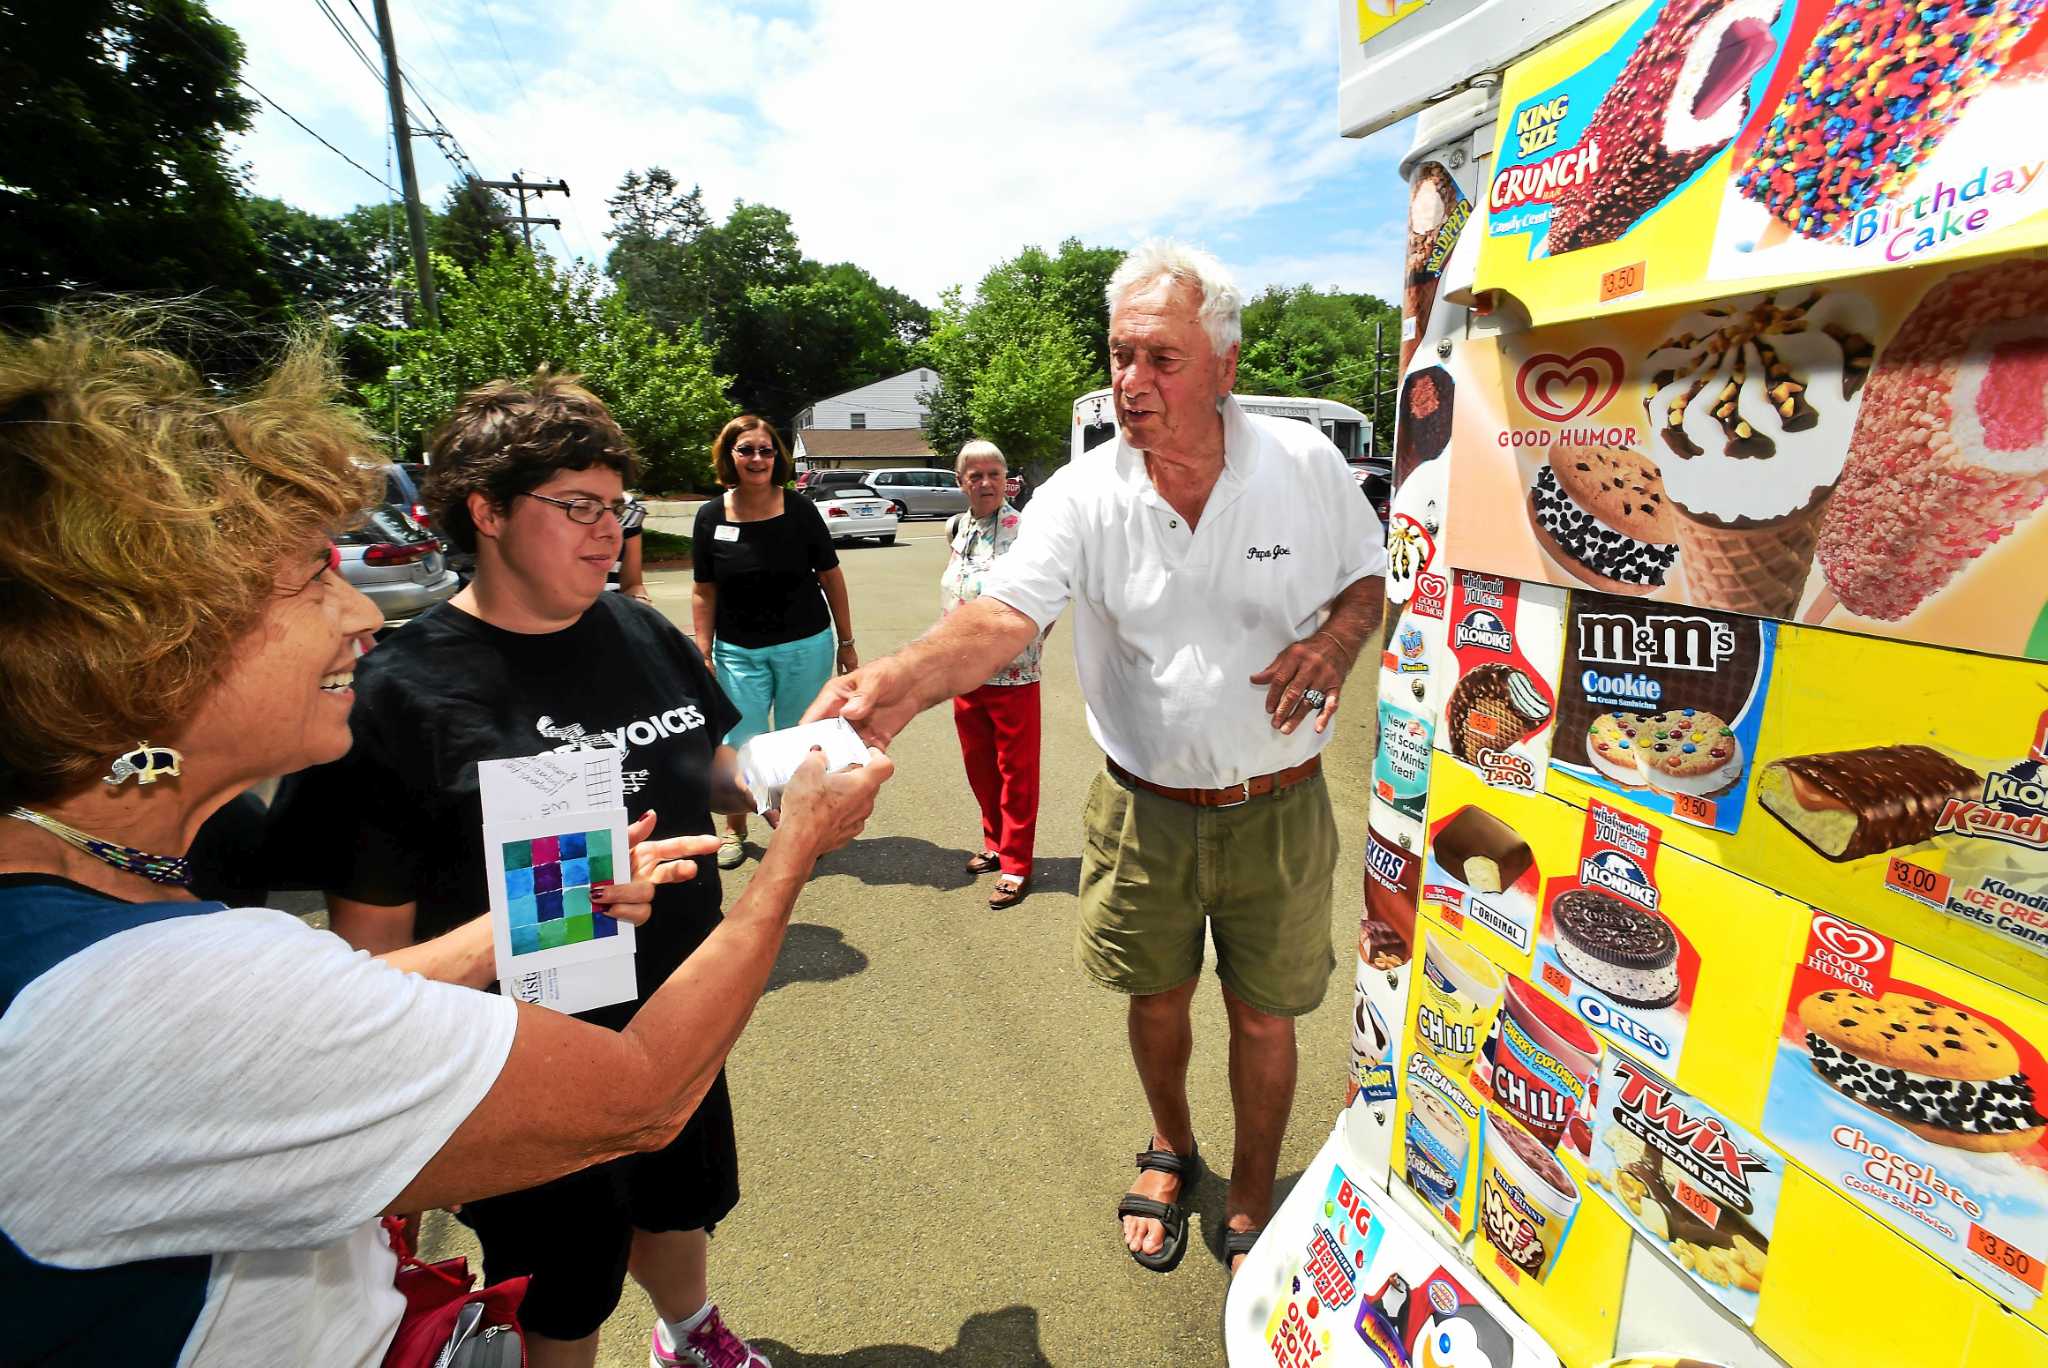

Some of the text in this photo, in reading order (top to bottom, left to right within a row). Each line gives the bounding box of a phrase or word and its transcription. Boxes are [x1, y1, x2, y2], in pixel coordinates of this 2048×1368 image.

[1516, 94, 1568, 136] KING
[1517, 121, 1559, 159] SIZE
[1490, 138, 1601, 209] CRUNCH
[1853, 161, 2046, 248] Birthday
[1885, 208, 1990, 263] Cake
[1497, 426, 1637, 448] GOOD HUMOR
[1246, 544, 1291, 562] Papa Joe
[1414, 602, 1444, 617] HUMOR
[1417, 596, 1441, 608] GOOD
[1455, 623, 1512, 652] KLONDIKE
[1582, 669, 1662, 700] Cookie
[601, 705, 706, 752] VOICES
[1387, 714, 1407, 730] New
[1398, 734, 1429, 757] Scouts
[1400, 751, 1427, 771] Mints
[1478, 749, 1532, 774] CHOCO
[1390, 760, 1416, 782] Treat!
[1484, 768, 1525, 786] TACO
[1988, 772, 2048, 809] KLO
[1592, 805, 1648, 843] what would
[1595, 822, 1619, 844] you
[1581, 859, 1657, 910] KLONDIKE
[1963, 888, 1999, 911] ICE
[1980, 877, 2048, 913] Klondi
[1478, 906, 1518, 940] ORIGINAL
[1807, 955, 1875, 996] HUMOR
[1815, 948, 1869, 978] GOOD
[1418, 1004, 1476, 1053] CHILL
[1579, 997, 1670, 1058] OREO
[1503, 1019, 1536, 1057] CHERRY
[1534, 1051, 1585, 1100] EXPLOSION
[1408, 1052, 1480, 1120] SCREAMERS
[1495, 1064, 1567, 1123] CHILL
[1408, 1148, 1456, 1188] SCREAMERS
[1620, 1113, 1746, 1208] ICE CREAM BARS
[1832, 1126, 1981, 1218] Chocolate
[1494, 1169, 1545, 1226] BLUE BUNNY
[1864, 1160, 1934, 1206] Chip
[1336, 1178, 1372, 1238] BIG
[1843, 1174, 1954, 1238] Cookie Sandwich
[1979, 1231, 2029, 1275] $3.50
[1287, 1301, 1322, 1362] ONLY
